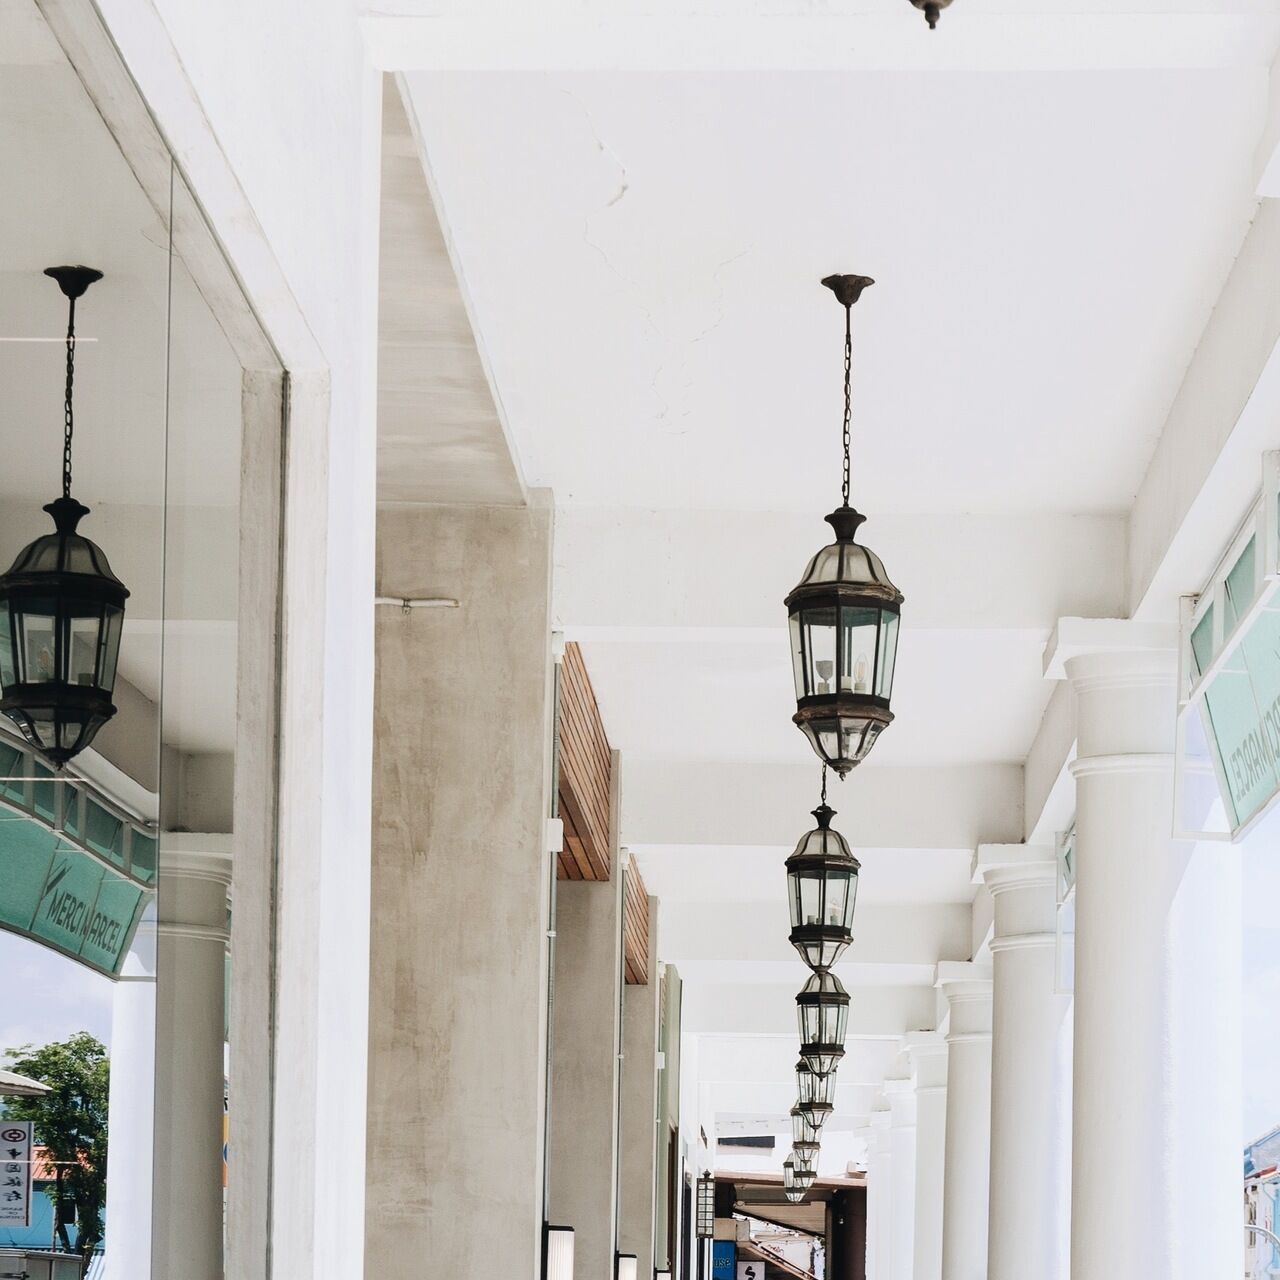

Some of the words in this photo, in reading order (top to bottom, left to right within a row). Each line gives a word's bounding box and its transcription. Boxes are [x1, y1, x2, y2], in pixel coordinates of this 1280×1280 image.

[46, 887, 87, 935] MERCI
[79, 906, 123, 955] MARCEL
[714, 1257, 731, 1268] use
